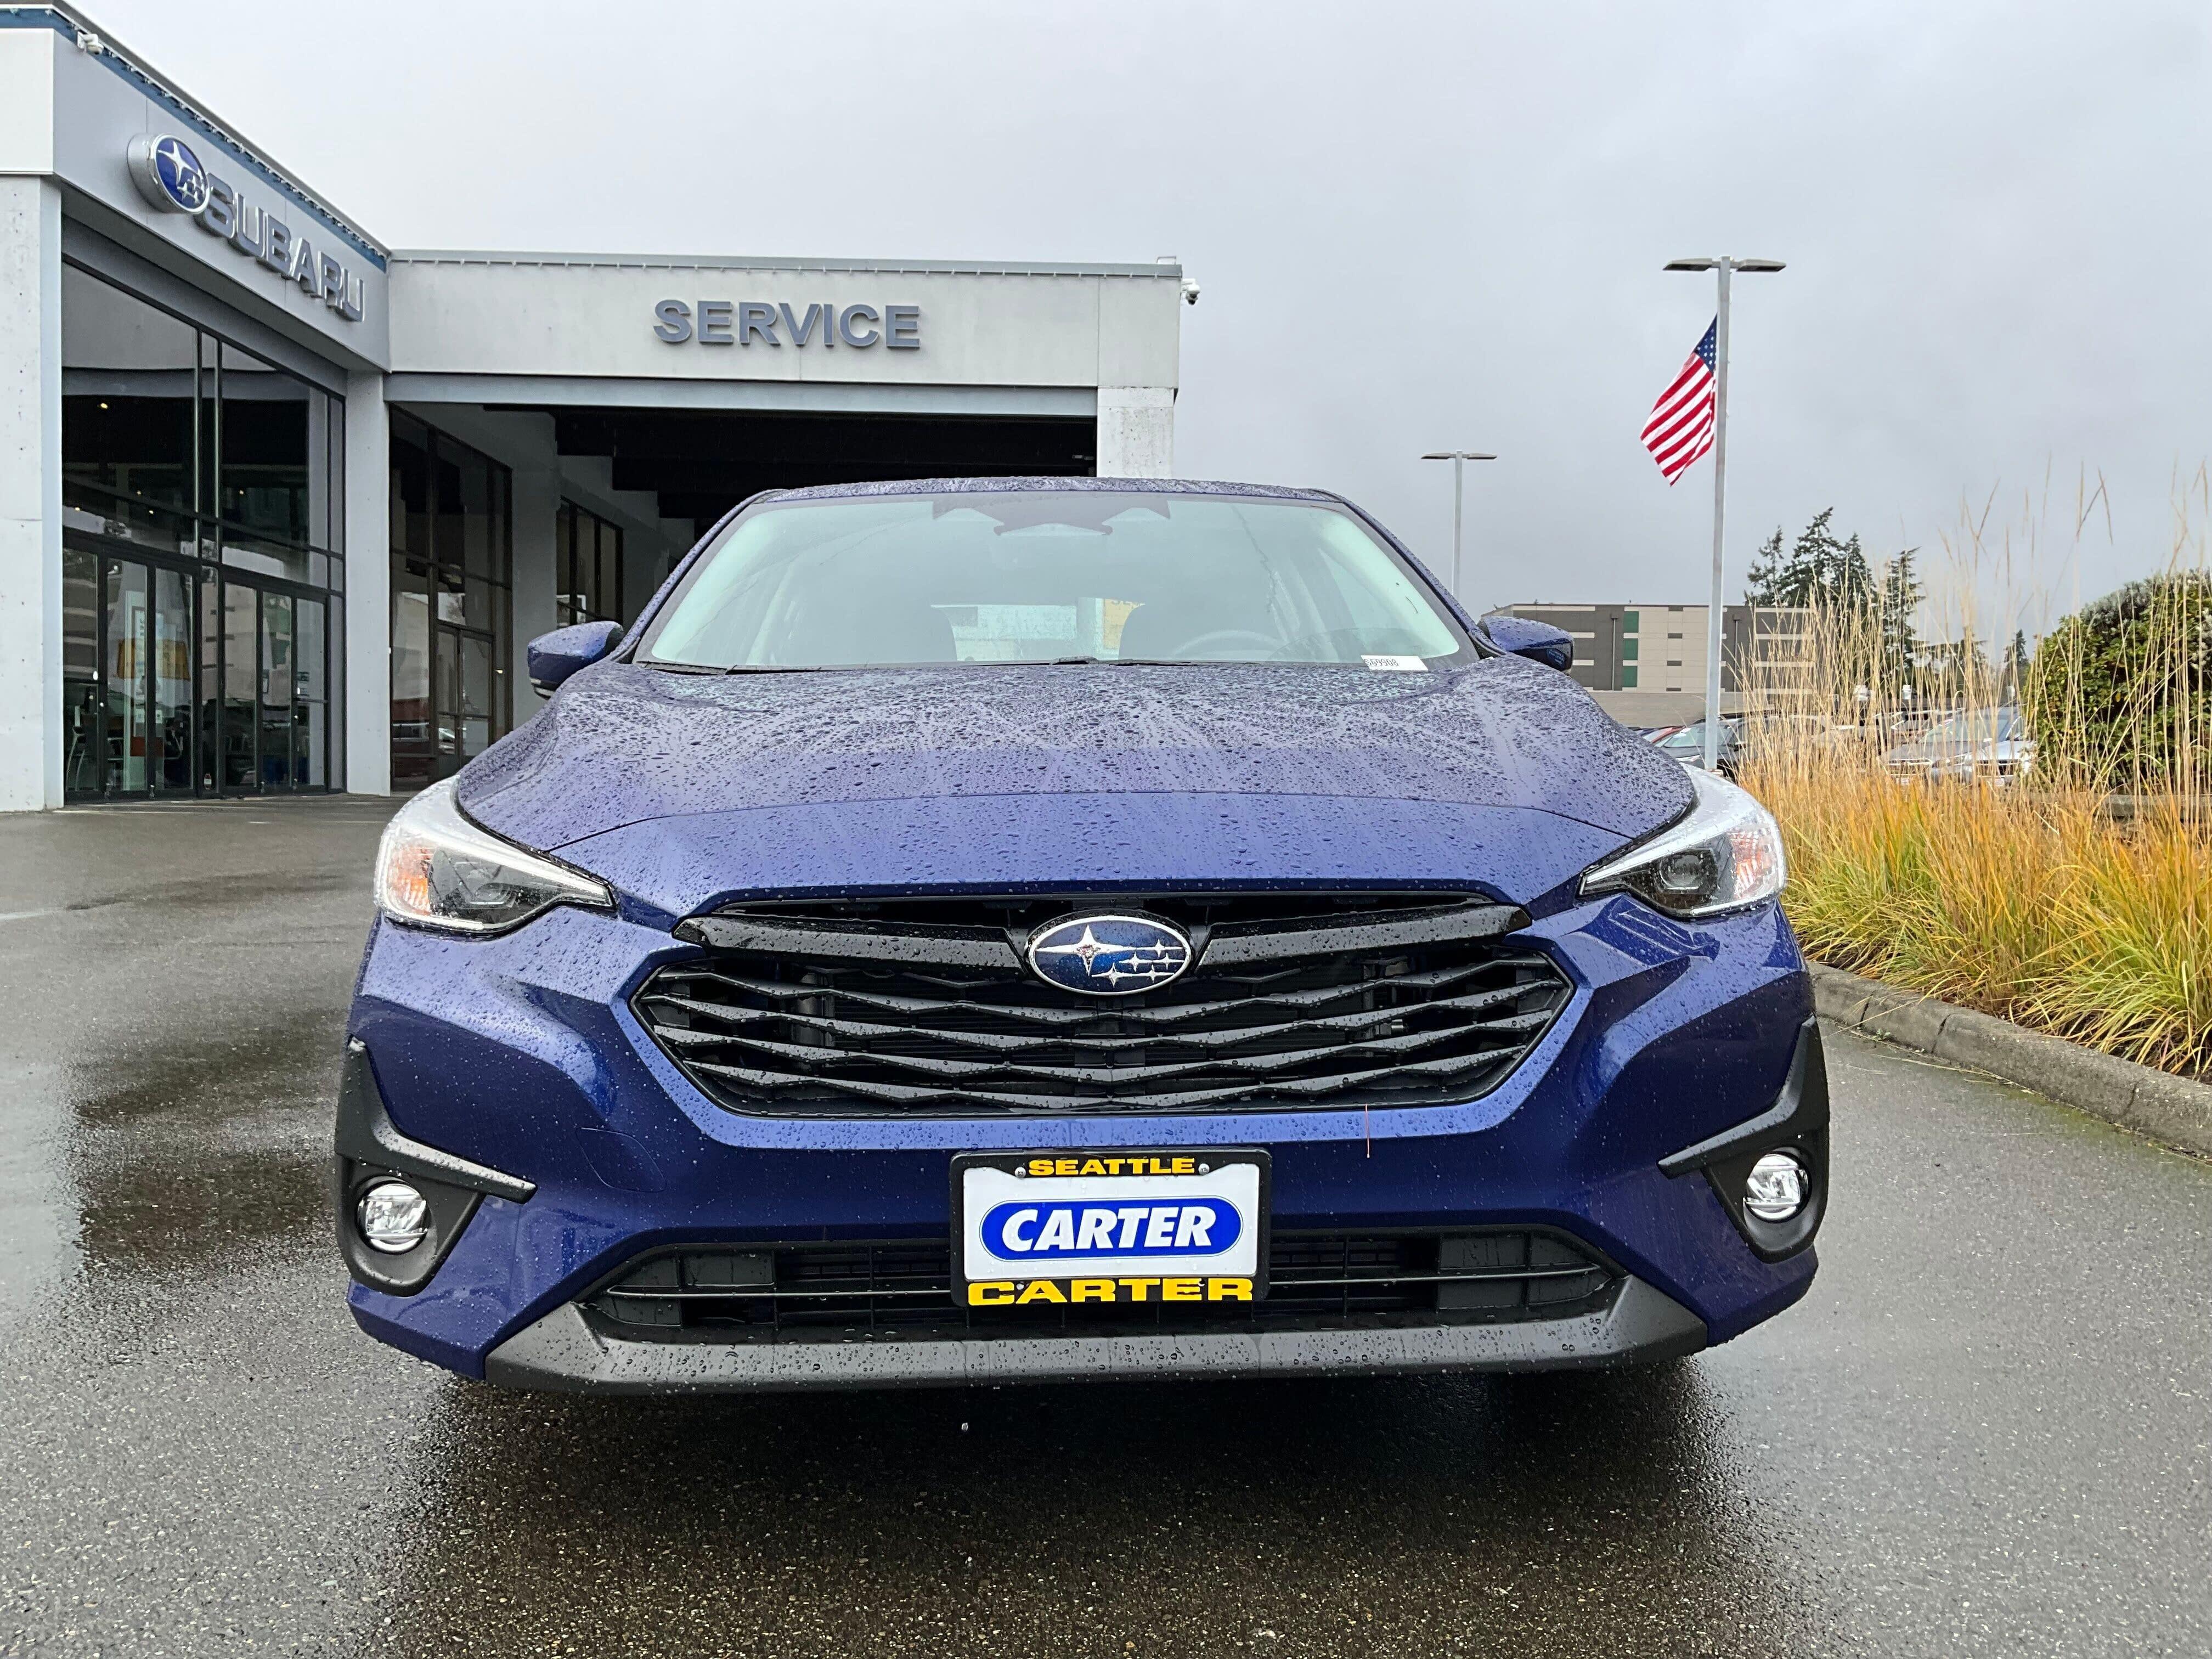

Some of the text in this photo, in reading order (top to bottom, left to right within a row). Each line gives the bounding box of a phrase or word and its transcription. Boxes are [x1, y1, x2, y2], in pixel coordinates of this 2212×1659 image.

[203, 172, 364, 322] SUBARU
[653, 299, 921, 348] SERVICE
[1029, 1158, 1195, 1176] SEATTLE
[1002, 1206, 1216, 1252] CARTER
[968, 1278, 1254, 1306] CARTER
